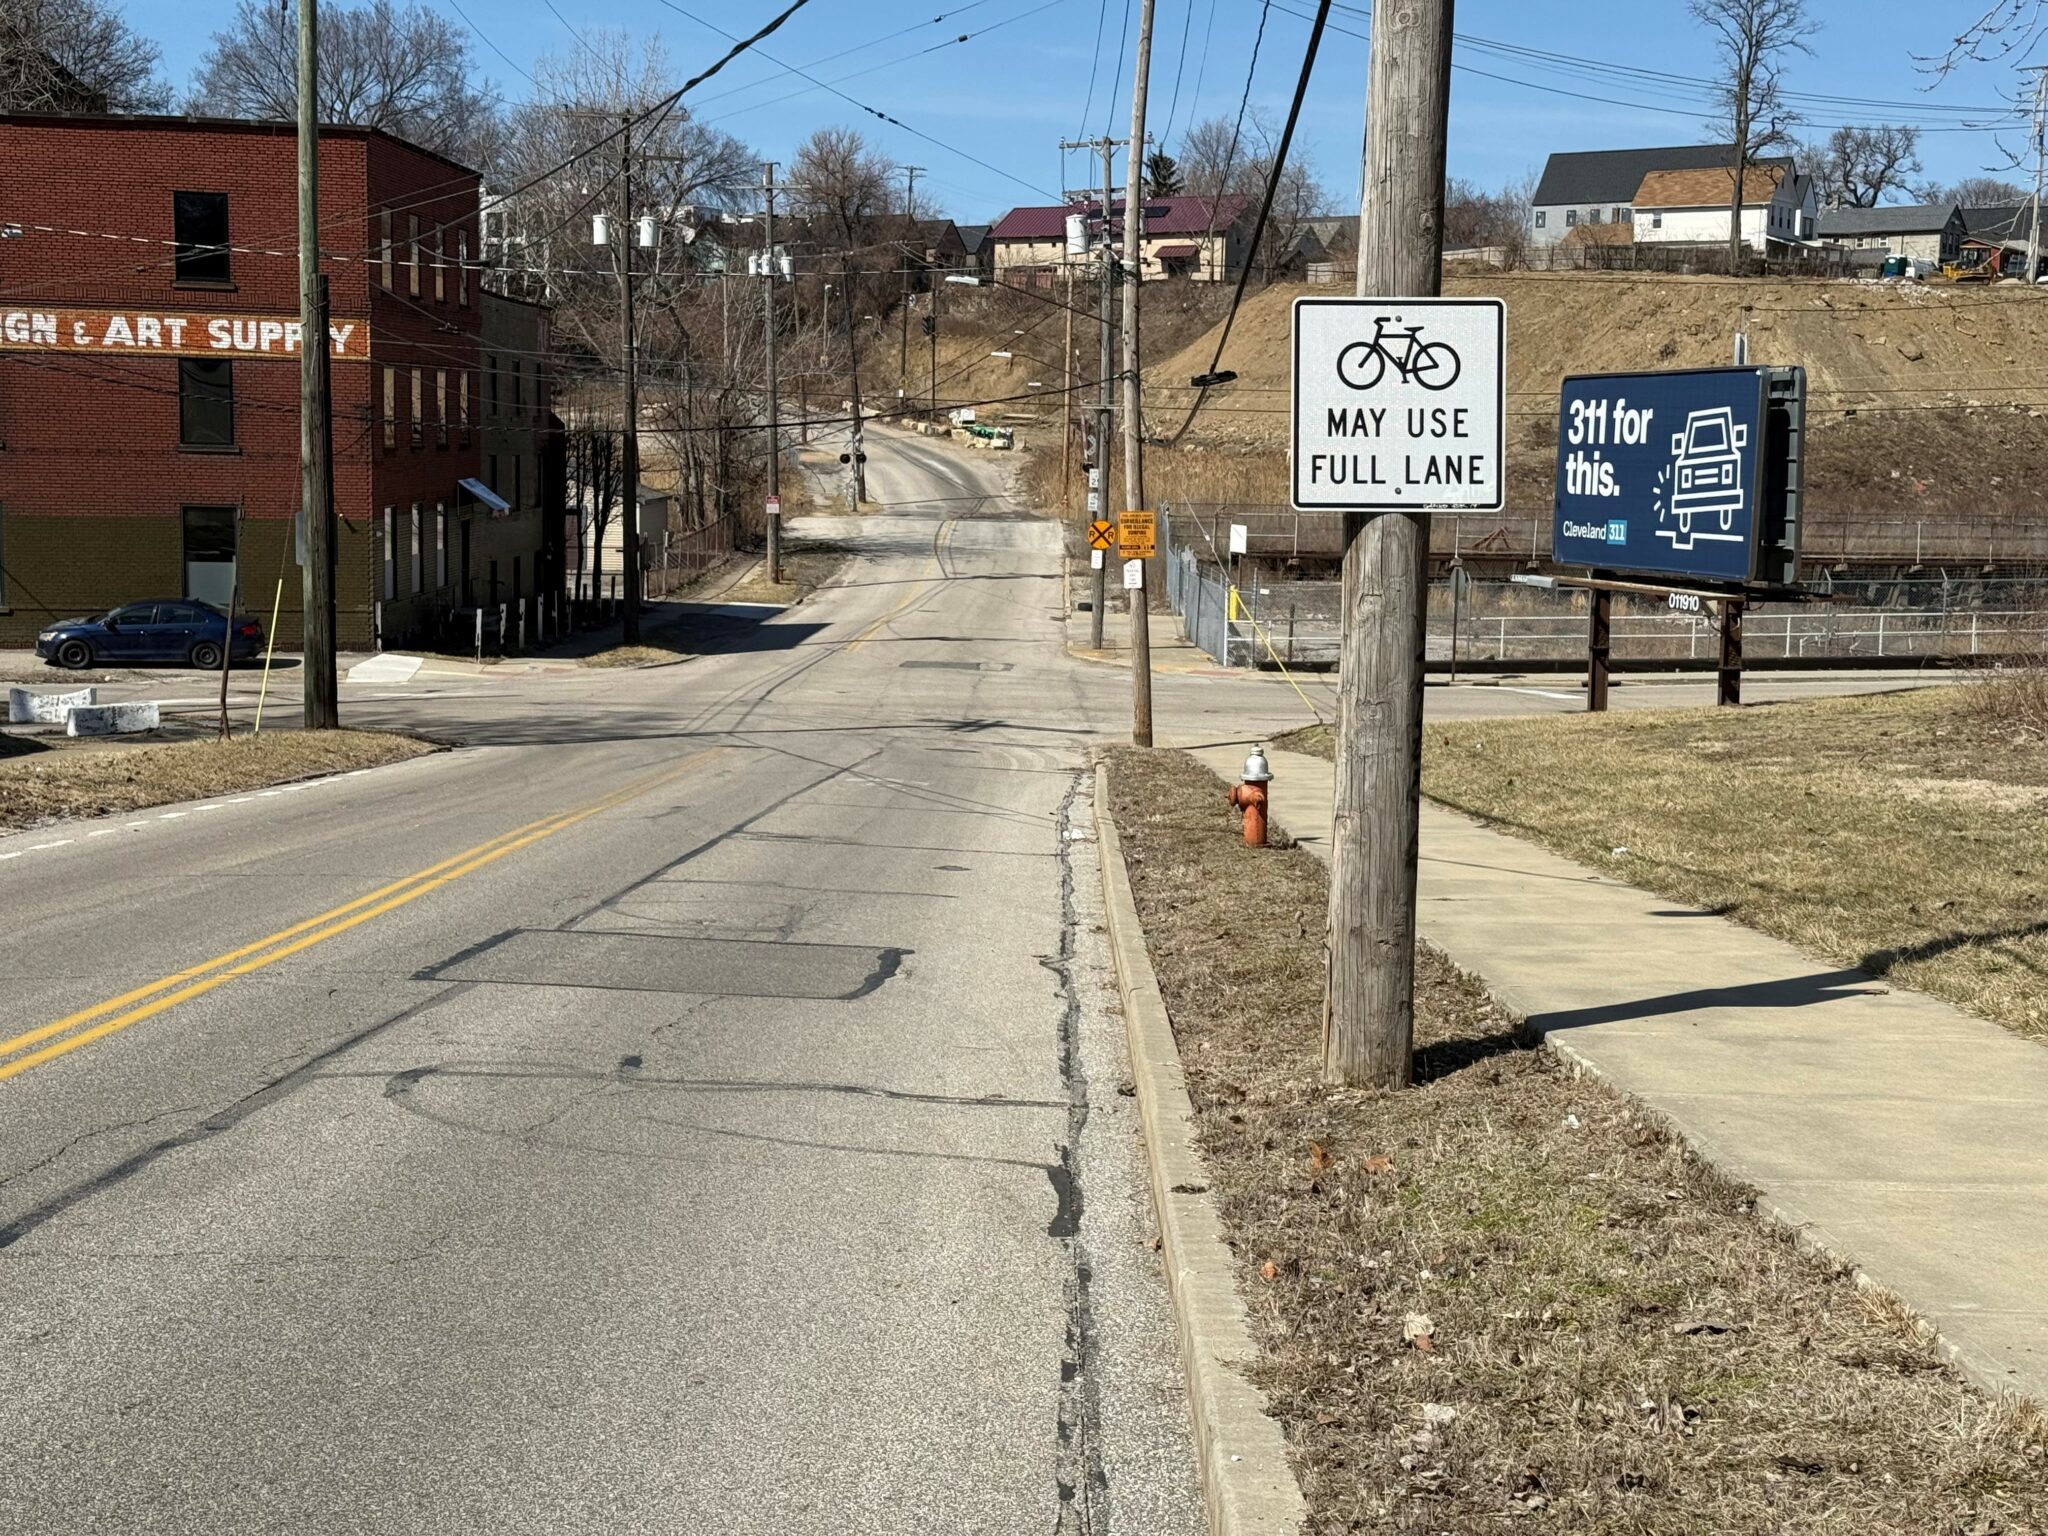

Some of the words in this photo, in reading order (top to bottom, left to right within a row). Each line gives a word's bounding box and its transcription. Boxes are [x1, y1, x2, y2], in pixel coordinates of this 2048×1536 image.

[0, 313, 57, 344] GN
[73, 321, 93, 345] &
[102, 316, 188, 348] ART
[207, 319, 355, 353] SUPPY
[1327, 408, 1387, 438] MAY
[1407, 408, 1469, 438] USE
[1568, 399, 1607, 445] 311
[1612, 398, 1653, 445] for
[1311, 454, 1387, 485] FULL
[1405, 454, 1485, 485] LANE
[1565, 450, 1620, 497] this.
[1089, 530, 1095, 538] R
[1563, 520, 1606, 541] Cleveland
[1608, 523, 1625, 541] 311
[1668, 592, 1700, 612] 011910
